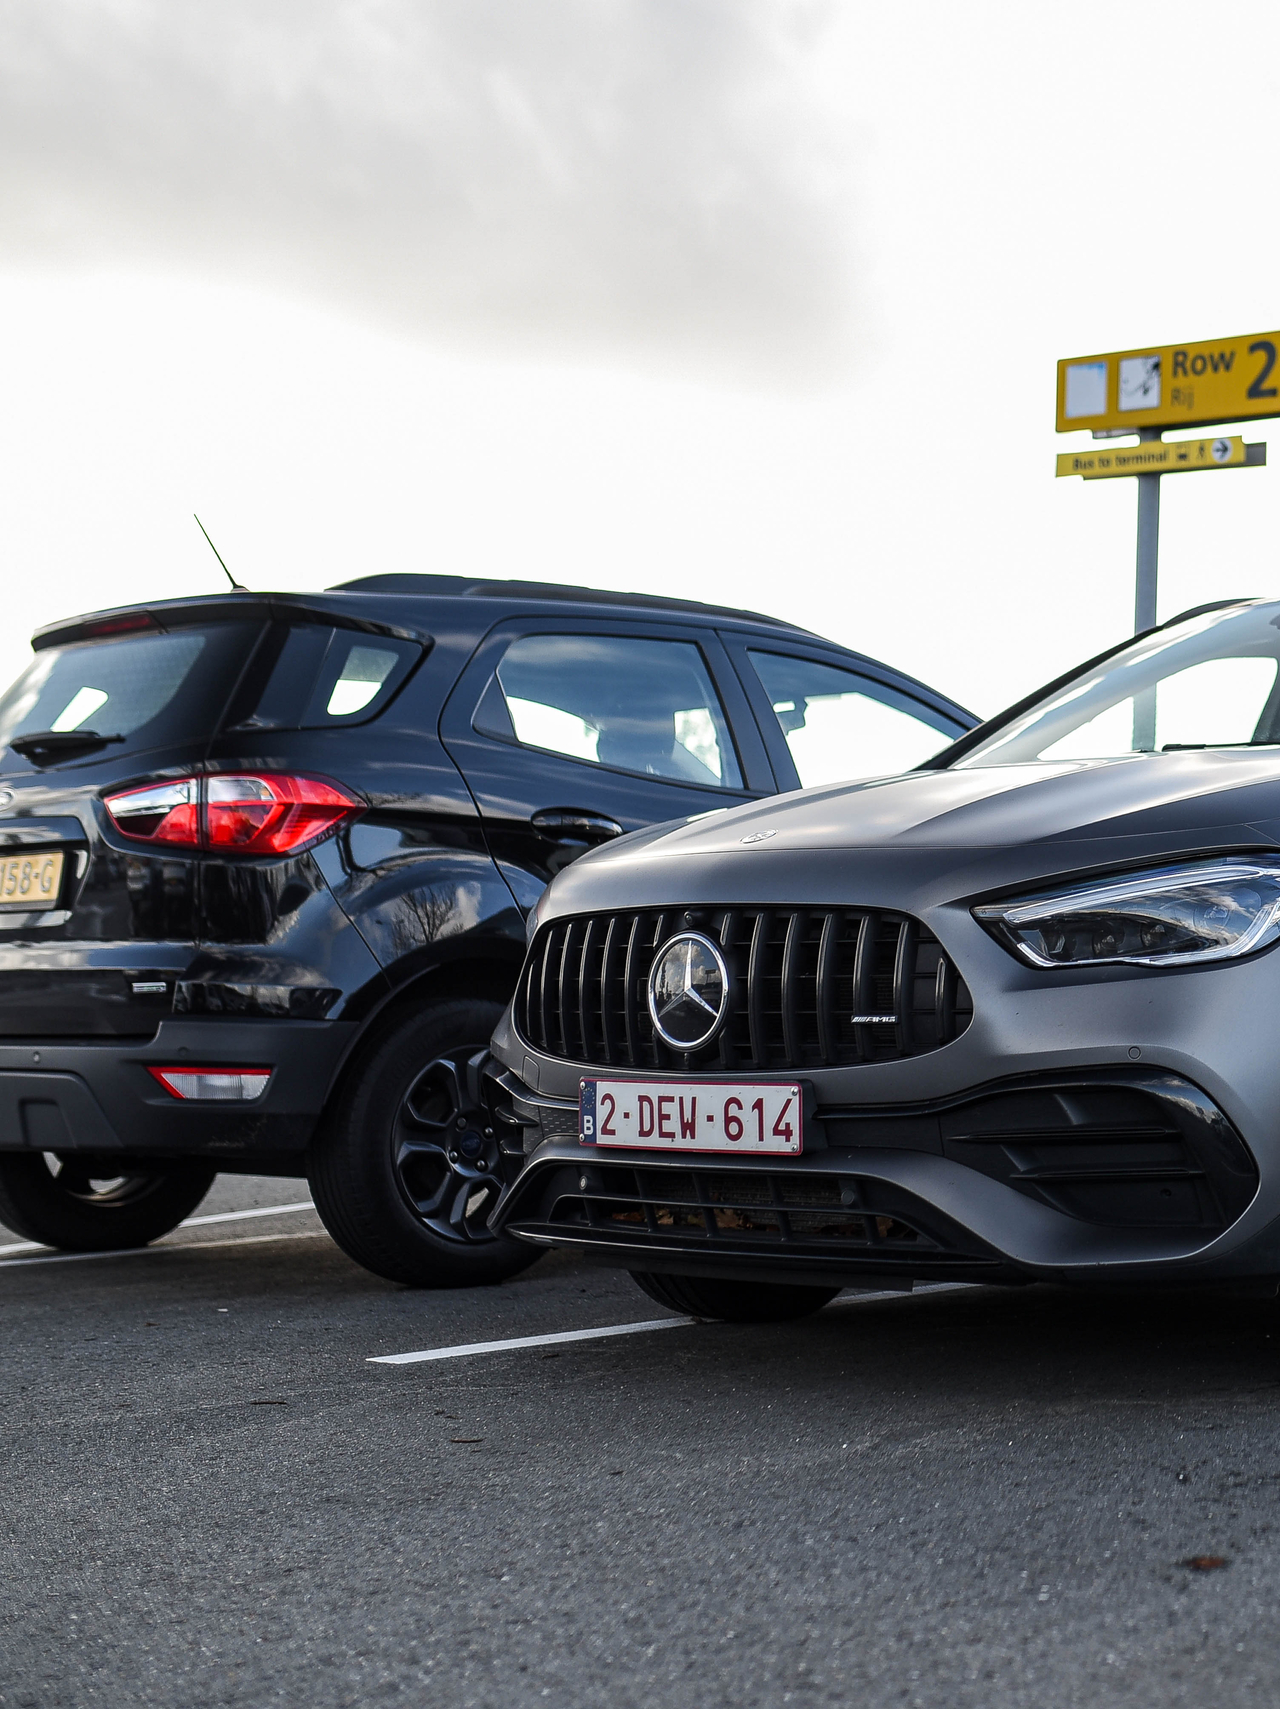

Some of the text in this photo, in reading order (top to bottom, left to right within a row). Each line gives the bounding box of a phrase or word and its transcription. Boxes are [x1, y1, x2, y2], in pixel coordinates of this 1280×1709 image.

[1173, 350, 1235, 377] Row
[1073, 458, 1094, 471] Bus
[1115, 449, 1168, 467] terminal
[583, 1115, 594, 1135] B
[600, 1093, 794, 1142] 2-DEW-614
